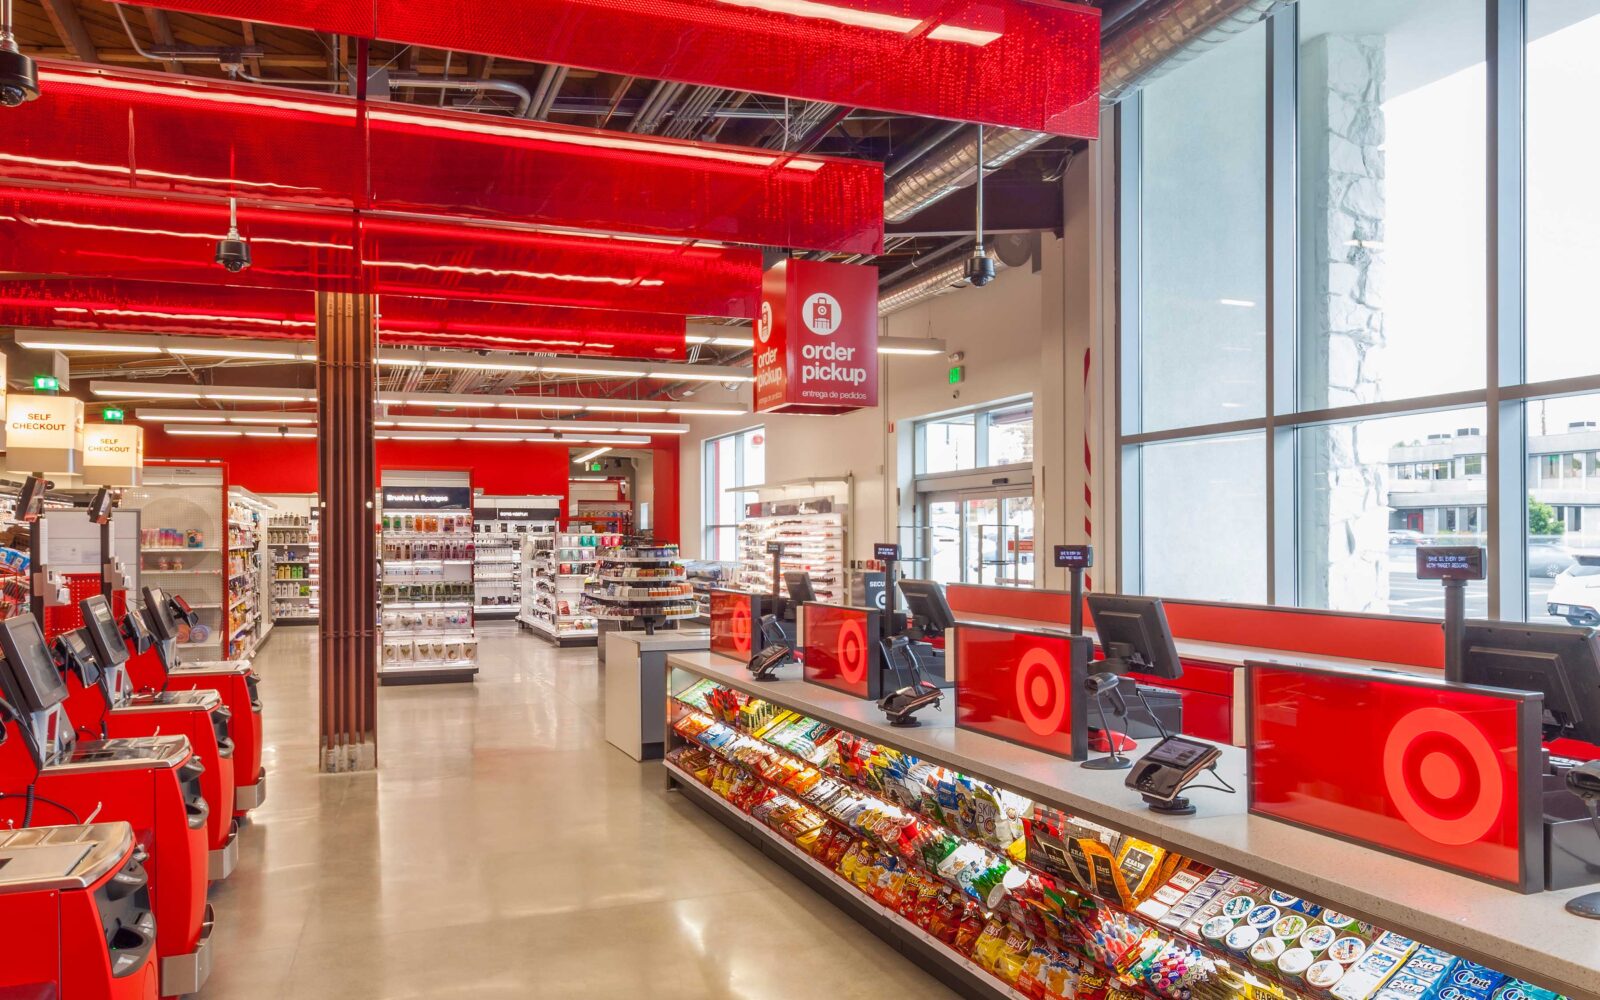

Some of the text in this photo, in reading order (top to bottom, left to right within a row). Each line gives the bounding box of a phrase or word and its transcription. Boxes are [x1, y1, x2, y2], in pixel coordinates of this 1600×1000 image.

[758, 346, 778, 368] order
[802, 341, 855, 361] order
[757, 367, 783, 392] pickup
[802, 361, 867, 386] pickup
[802, 390, 867, 400] entrega de pedidos
[27, 413, 52, 421] SELF
[12, 423, 66, 431] CHECKOUT
[1407, 958, 1444, 972] Extra
[1388, 979, 1426, 993] Extra
[1454, 970, 1491, 990] Orbit
